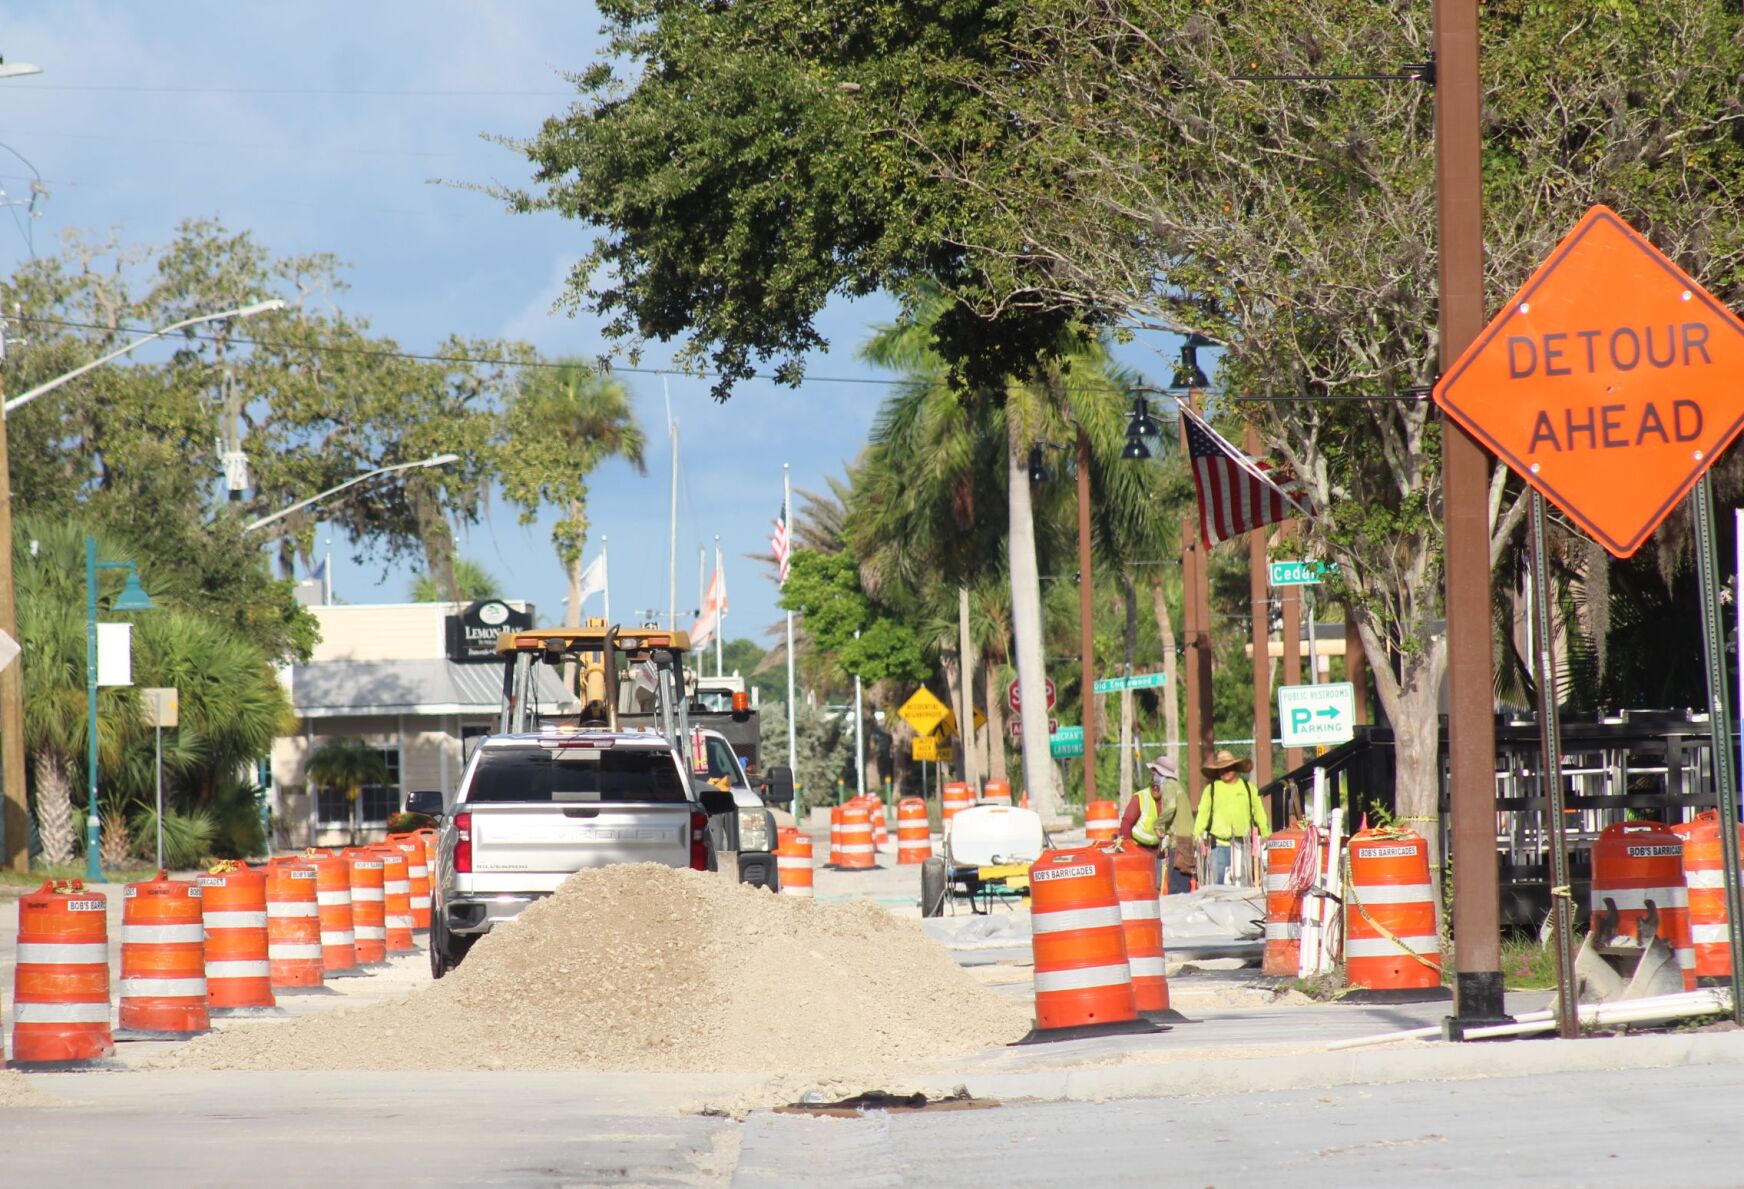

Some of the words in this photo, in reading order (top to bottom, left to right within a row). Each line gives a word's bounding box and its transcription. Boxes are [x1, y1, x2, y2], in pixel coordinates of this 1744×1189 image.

[1507, 322, 1712, 379] DETOUR
[1528, 400, 1704, 454] AHEAD
[465, 625, 500, 640] LEMON
[1110, 677, 1152, 689] Engewood
[1012, 687, 1053, 705] SP
[1283, 691, 1308, 701] PUBLIC
[1310, 688, 1349, 700] RESTROOMS
[1291, 708, 1342, 734] PARKING
[1360, 848, 1376, 857] BOB'S
[1378, 847, 1416, 856] BARRICADES
[1629, 847, 1652, 856] BOB'S
[1034, 871, 1050, 880] BOB'S
[1052, 866, 1093, 879] BARRICADES
[70, 901, 89, 910] BOB'S
